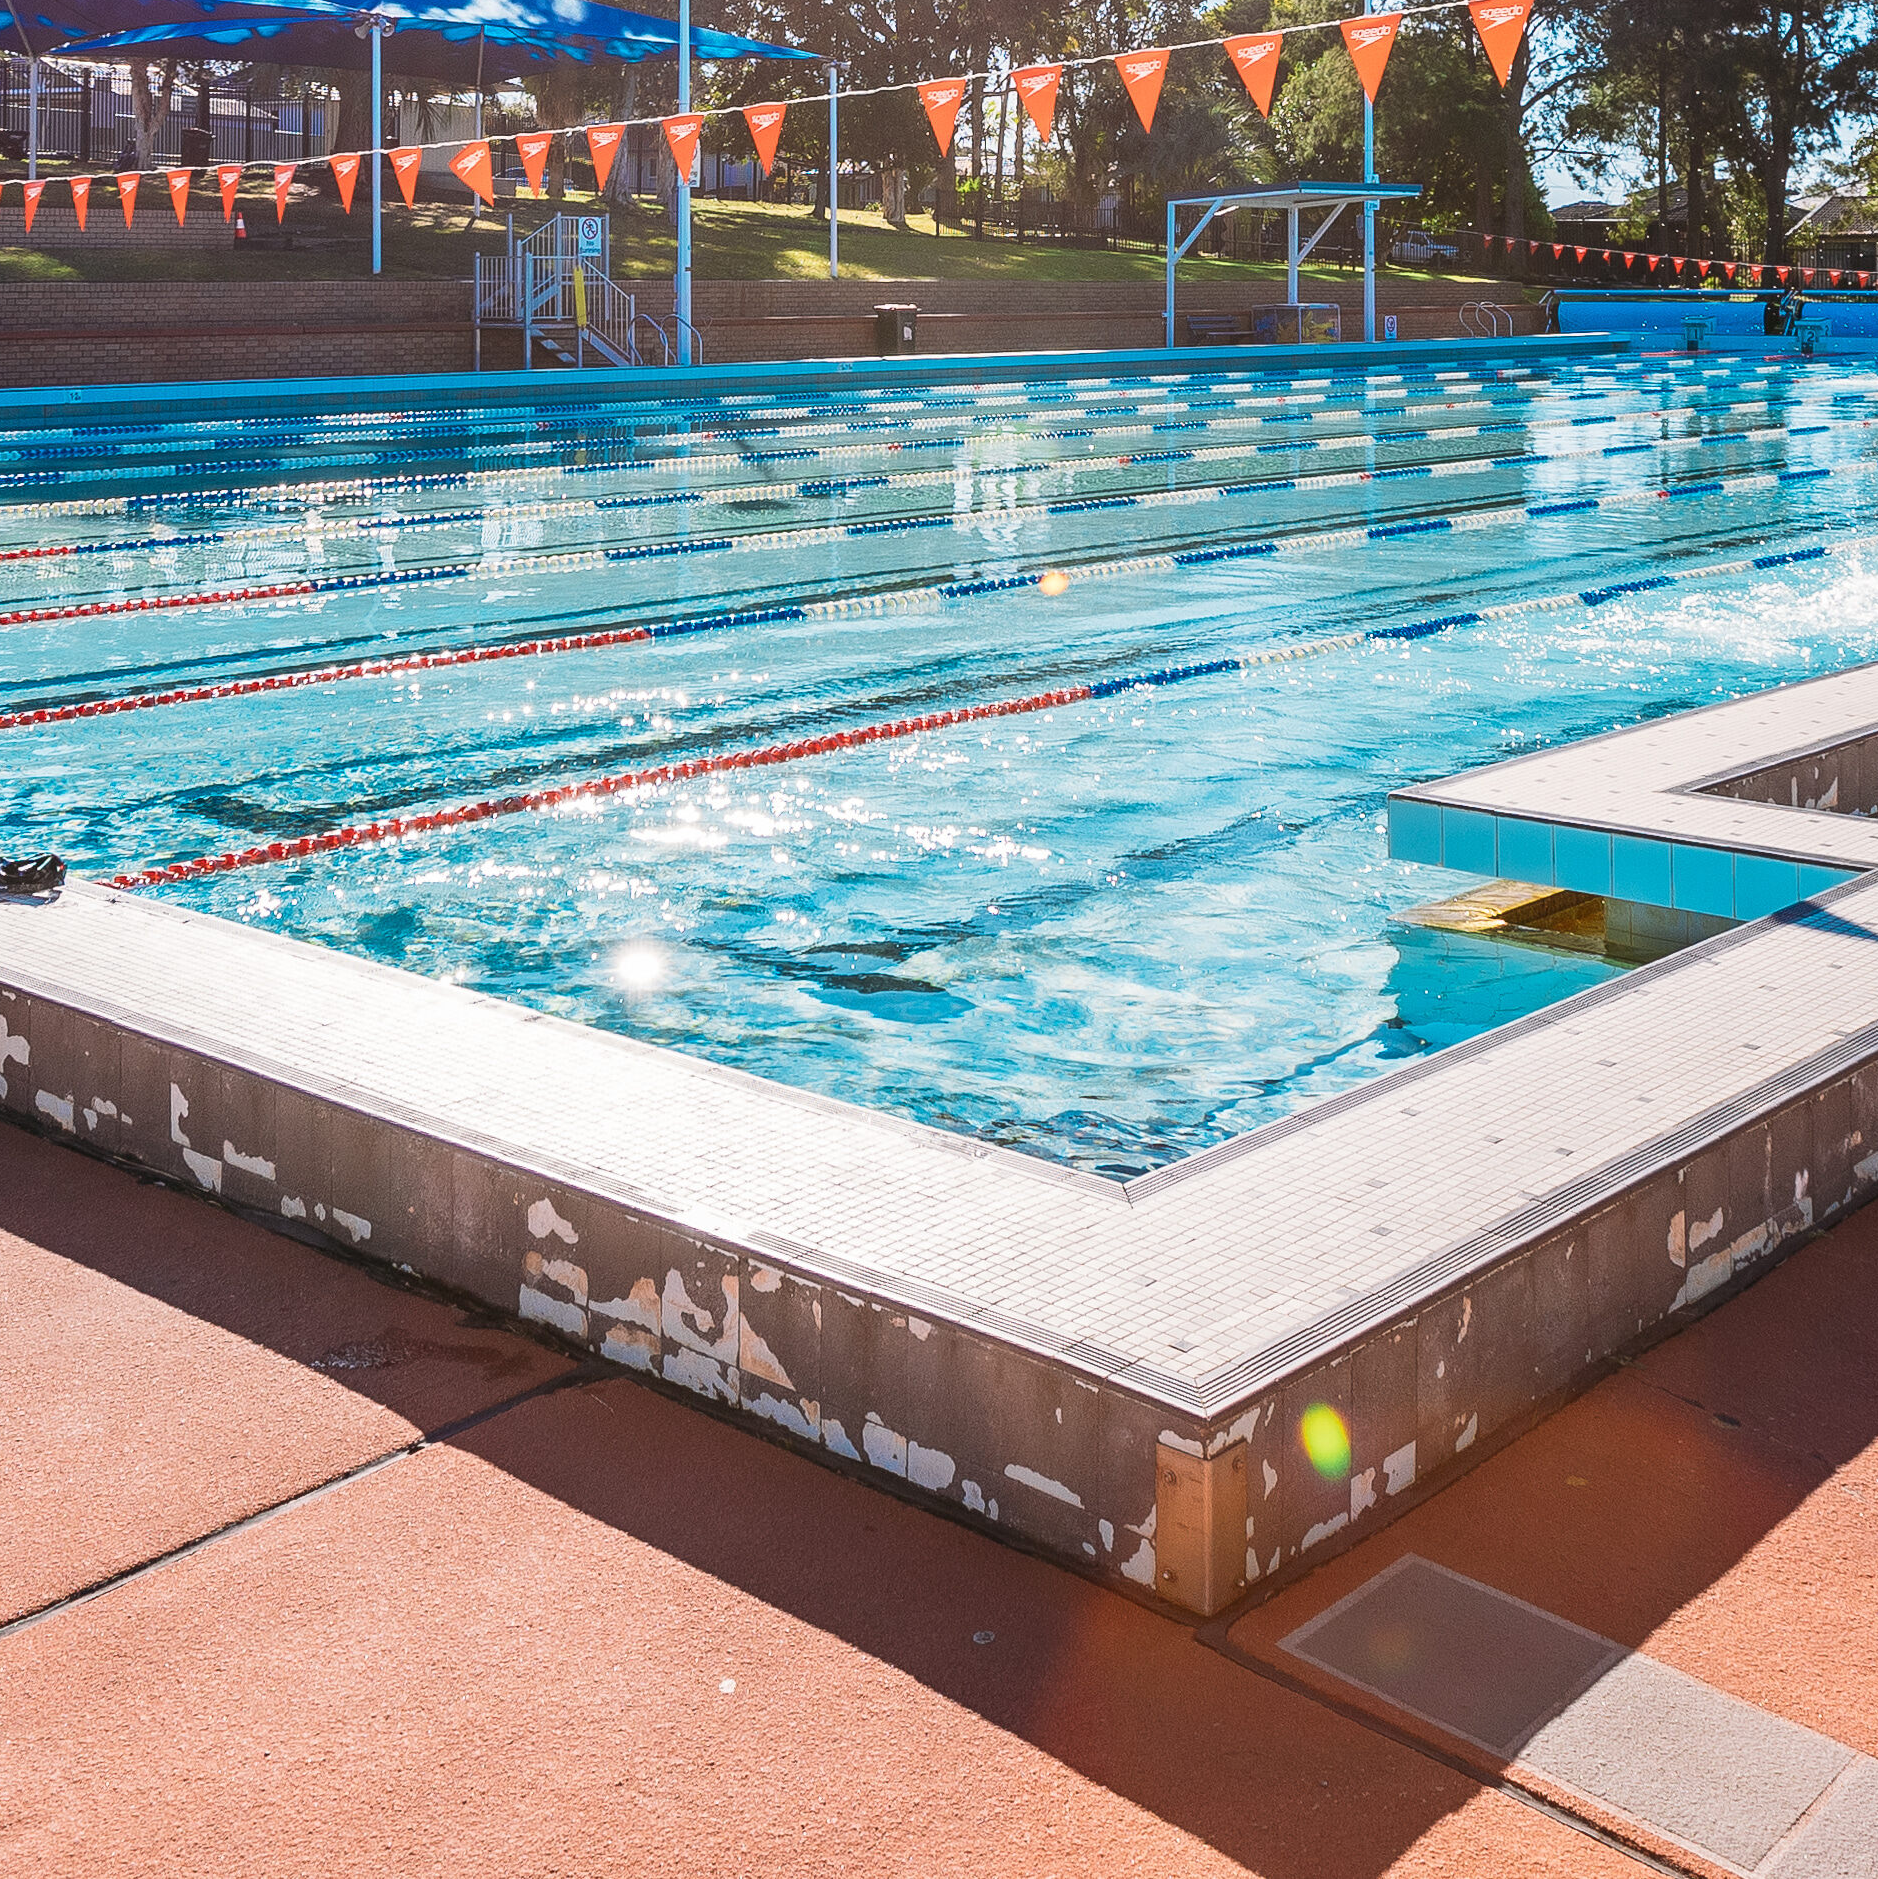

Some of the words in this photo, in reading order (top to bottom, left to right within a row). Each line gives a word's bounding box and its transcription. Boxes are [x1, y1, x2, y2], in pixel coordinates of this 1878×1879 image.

[1479, 3, 1524, 20] speedo
[1350, 24, 1392, 40] speedo
[1237, 40, 1276, 59] speedo
[1125, 59, 1162, 76] speedo
[1021, 72, 1056, 89] speedo
[927, 88, 959, 101] speedo
[1807, 331, 1815, 342] 2
